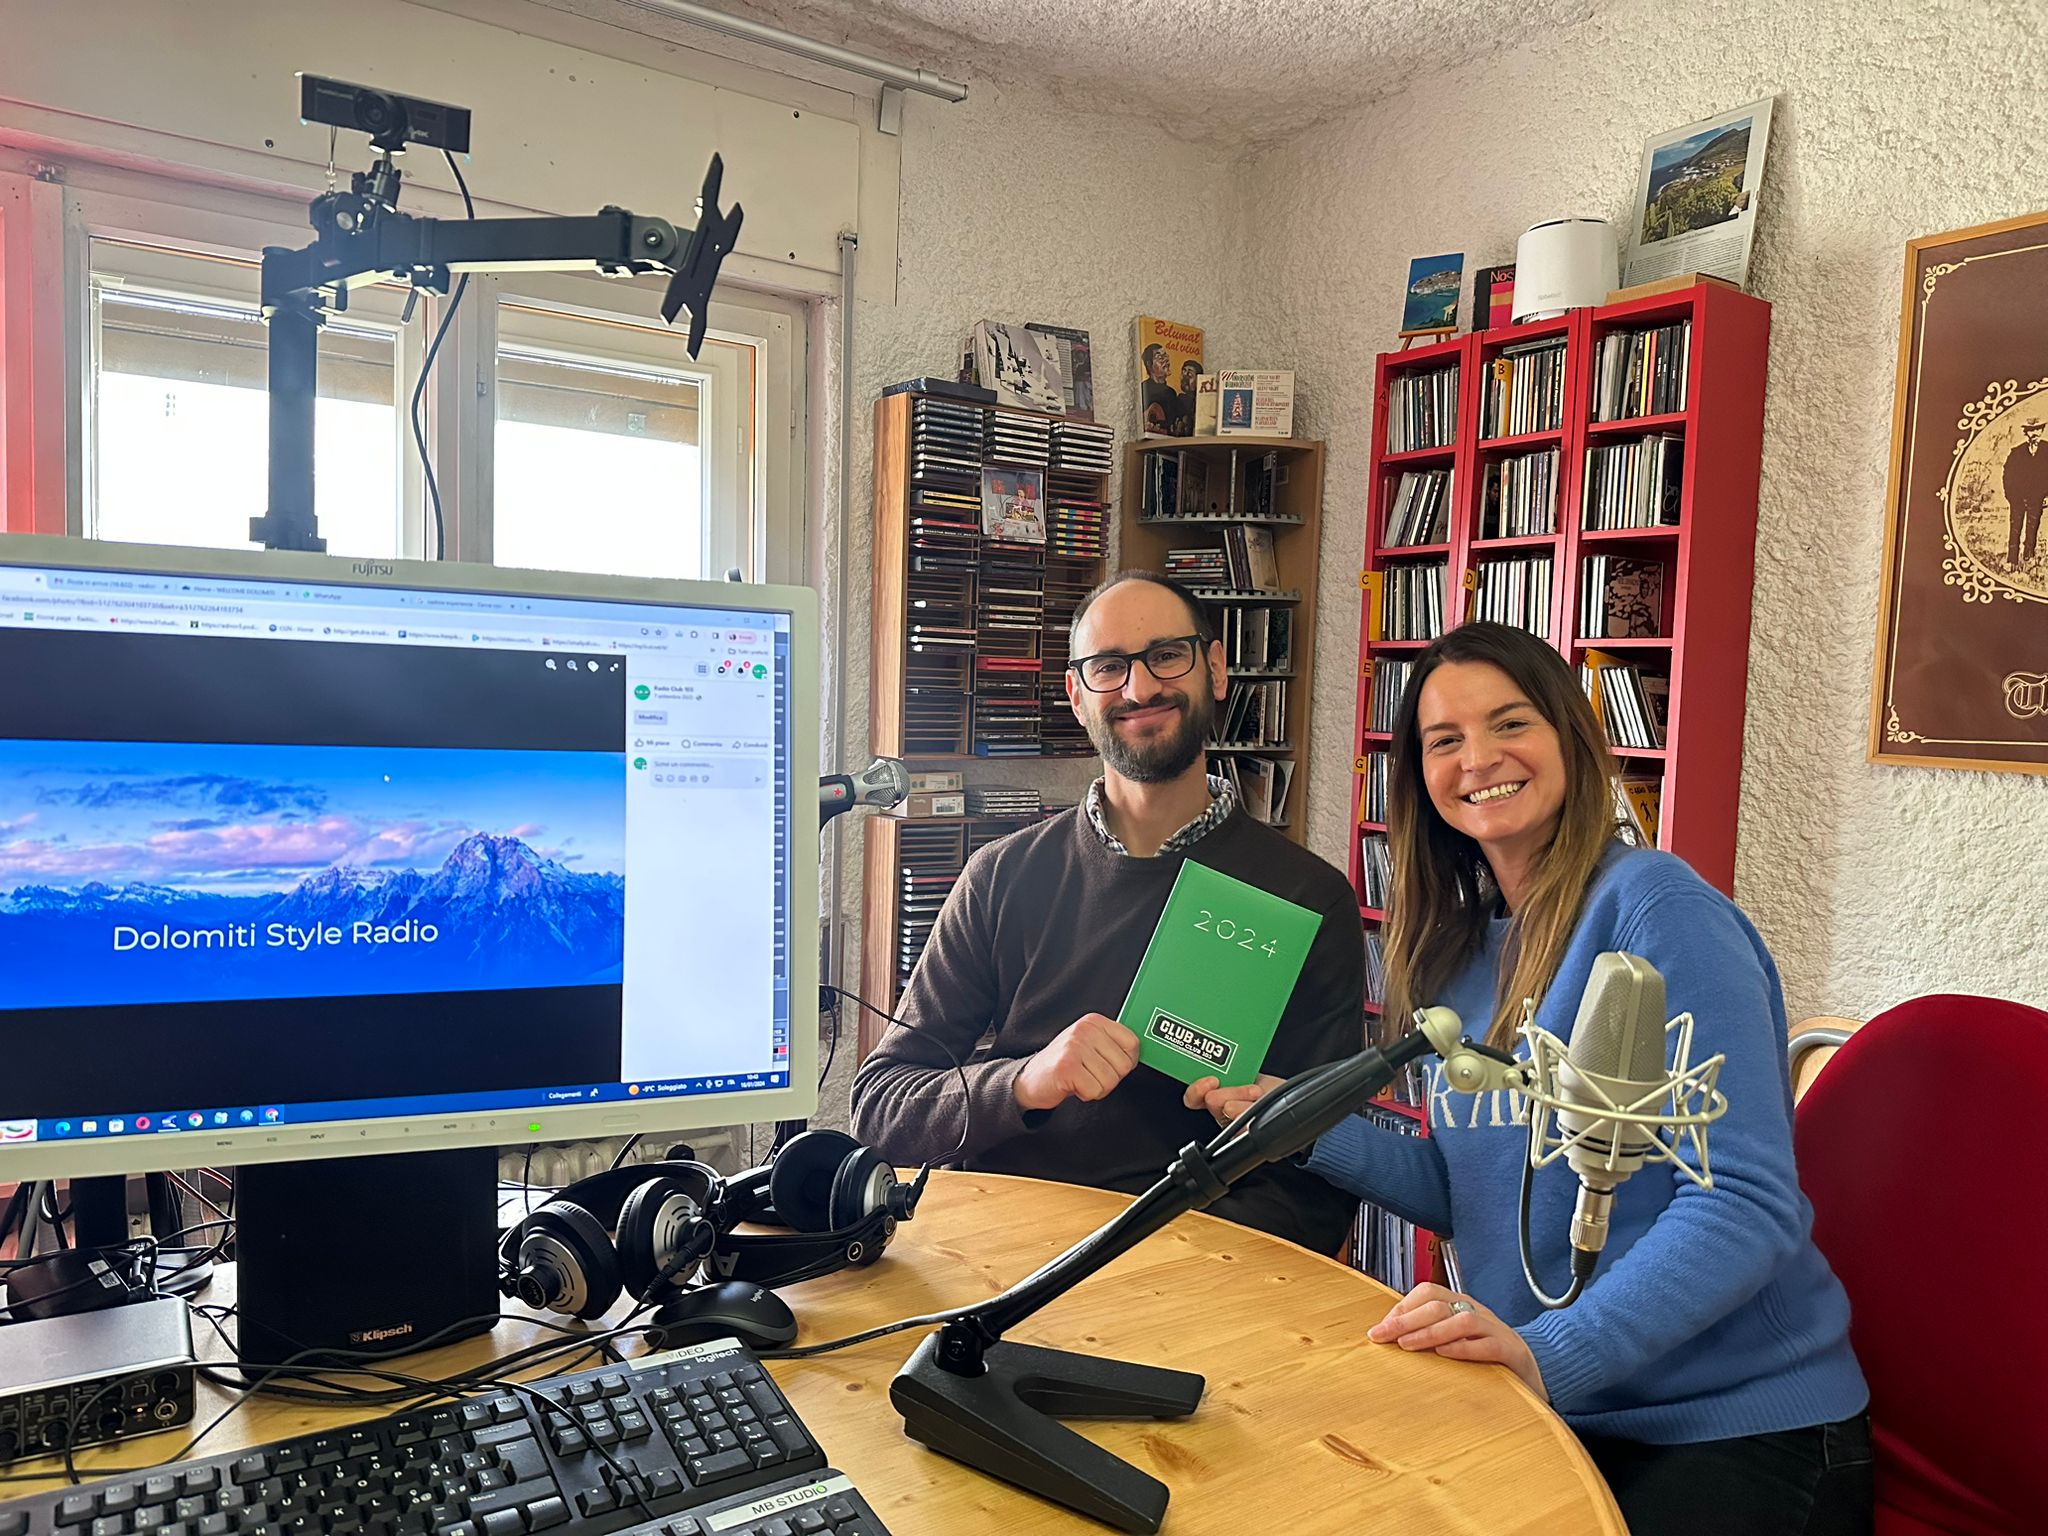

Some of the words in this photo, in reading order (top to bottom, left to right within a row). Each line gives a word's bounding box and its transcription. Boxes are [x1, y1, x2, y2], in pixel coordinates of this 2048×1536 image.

[1154, 320, 1200, 344] Belumat
[1498, 363, 1505, 375] B
[352, 560, 393, 577] FUJITSU
[1361, 574, 1370, 586] C
[1364, 662, 1371, 673] E
[1355, 758, 1364, 769] G
[113, 923, 256, 951] Dolomiti
[266, 922, 343, 951] Style
[352, 919, 439, 944] Radio
[1193, 910, 1277, 958] 2024
[362, 1324, 413, 1341] Klipsch
[695, 1347, 740, 1363] logitech
[752, 1502, 775, 1516] MB
[776, 1485, 828, 1507] STUDIO
